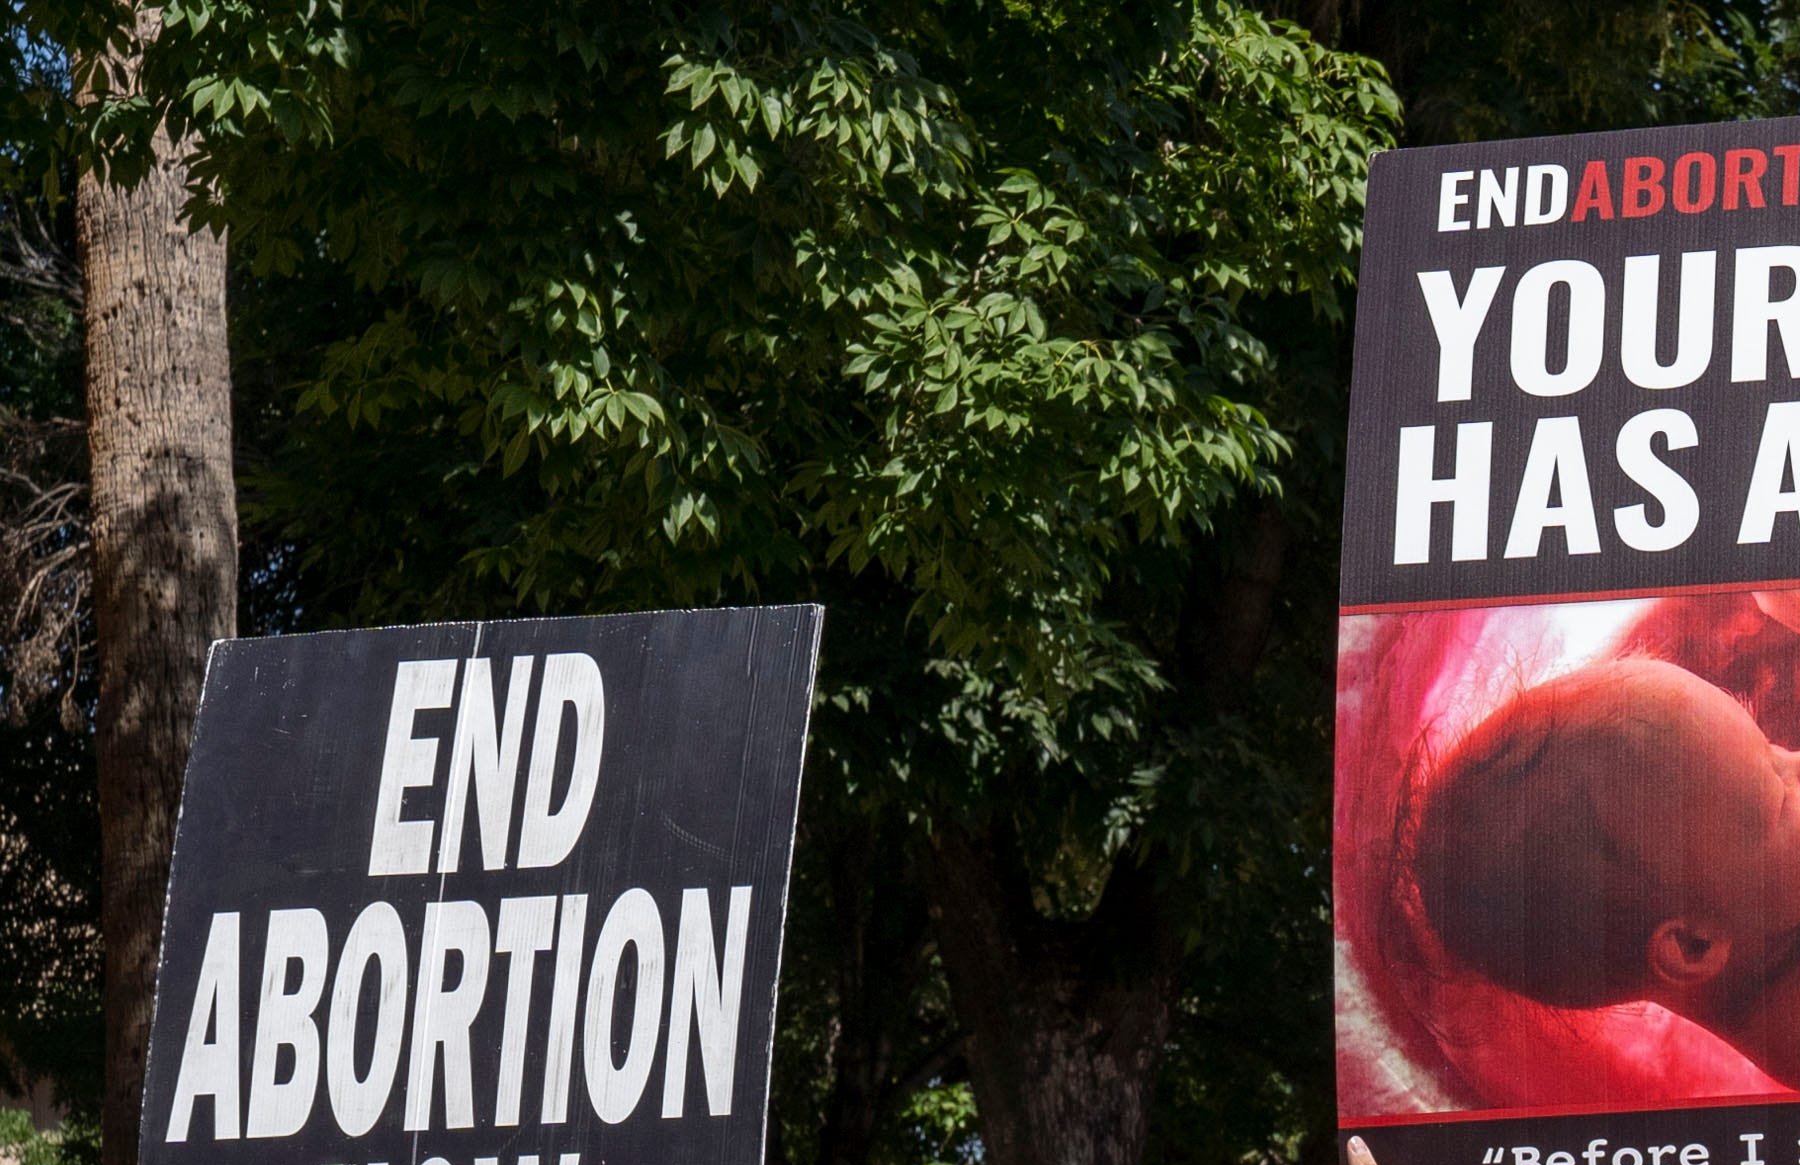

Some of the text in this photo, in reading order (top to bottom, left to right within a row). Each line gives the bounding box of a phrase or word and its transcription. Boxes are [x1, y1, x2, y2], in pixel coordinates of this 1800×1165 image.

[1393, 408, 1700, 565] HAS
[367, 652, 605, 877] END
[166, 886, 752, 1143] ABORTION
